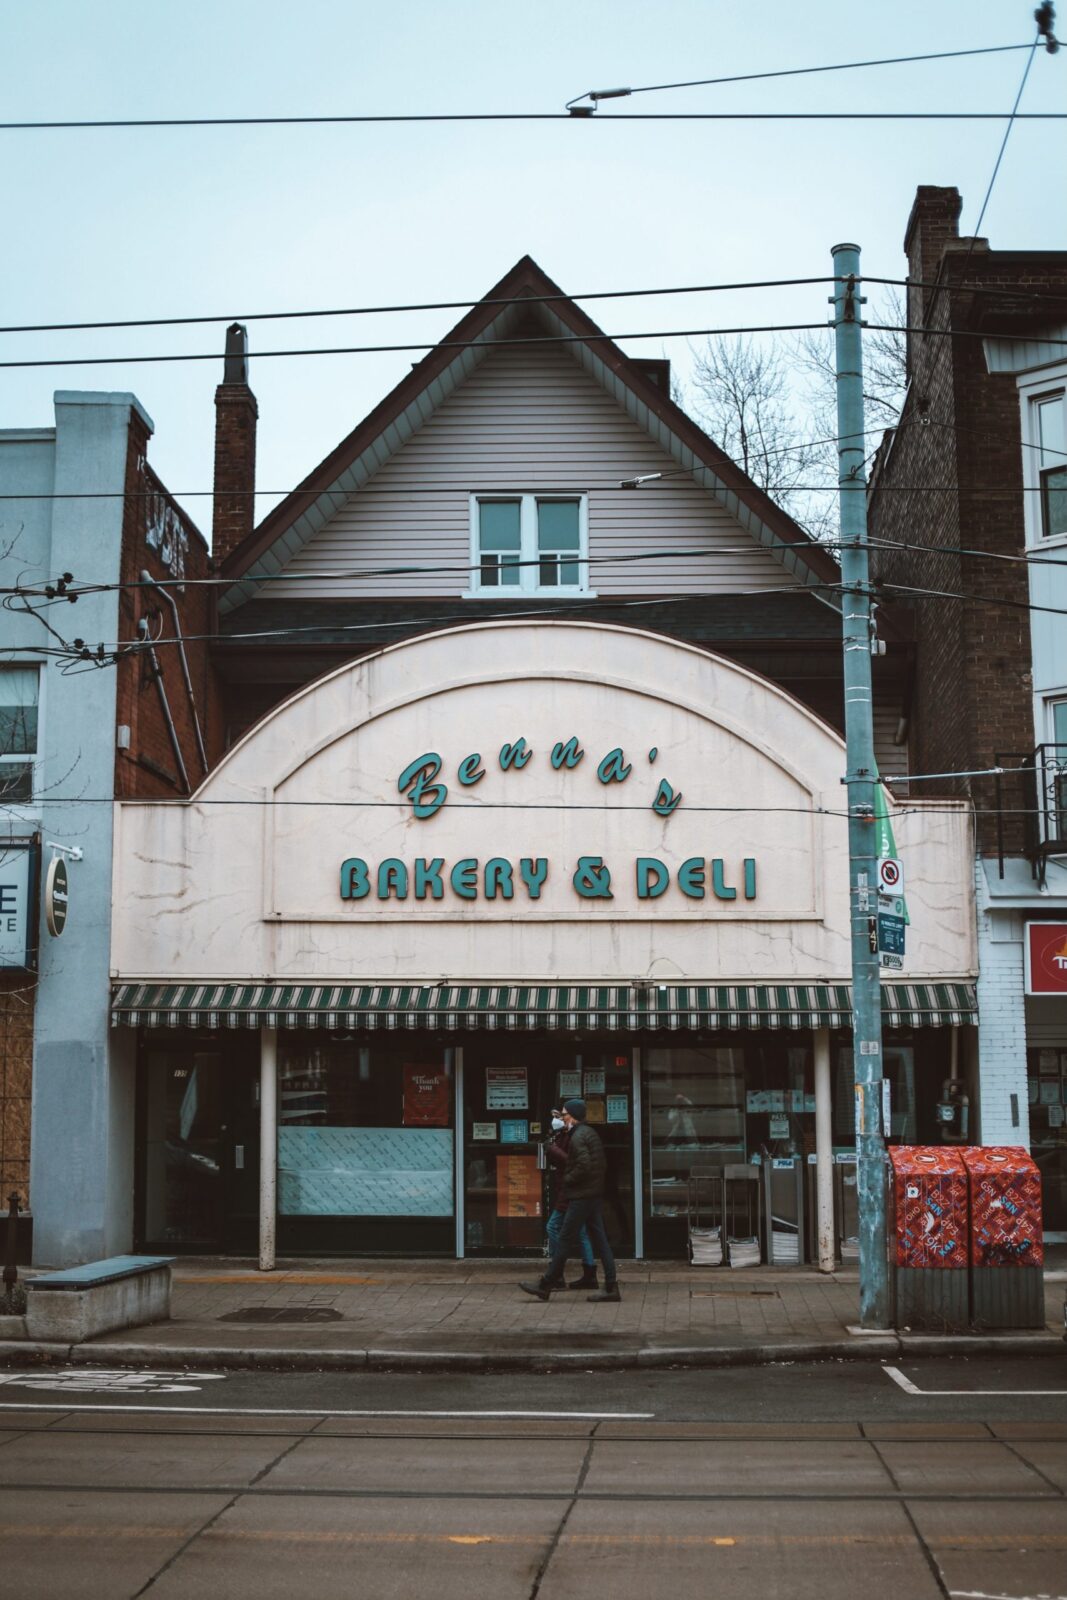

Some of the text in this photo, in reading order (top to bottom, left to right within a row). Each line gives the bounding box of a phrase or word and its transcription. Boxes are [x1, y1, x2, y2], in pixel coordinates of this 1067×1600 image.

[397, 735, 683, 820] Benna's
[340, 856, 757, 900] BAKERY & DELI
[411, 1074, 440, 1085] Thank
[418, 1084, 433, 1093] you
[925, 1196, 943, 1217] S4N
[1000, 1195, 1018, 1216] S4N
[1005, 1187, 1024, 1208] B2Z
